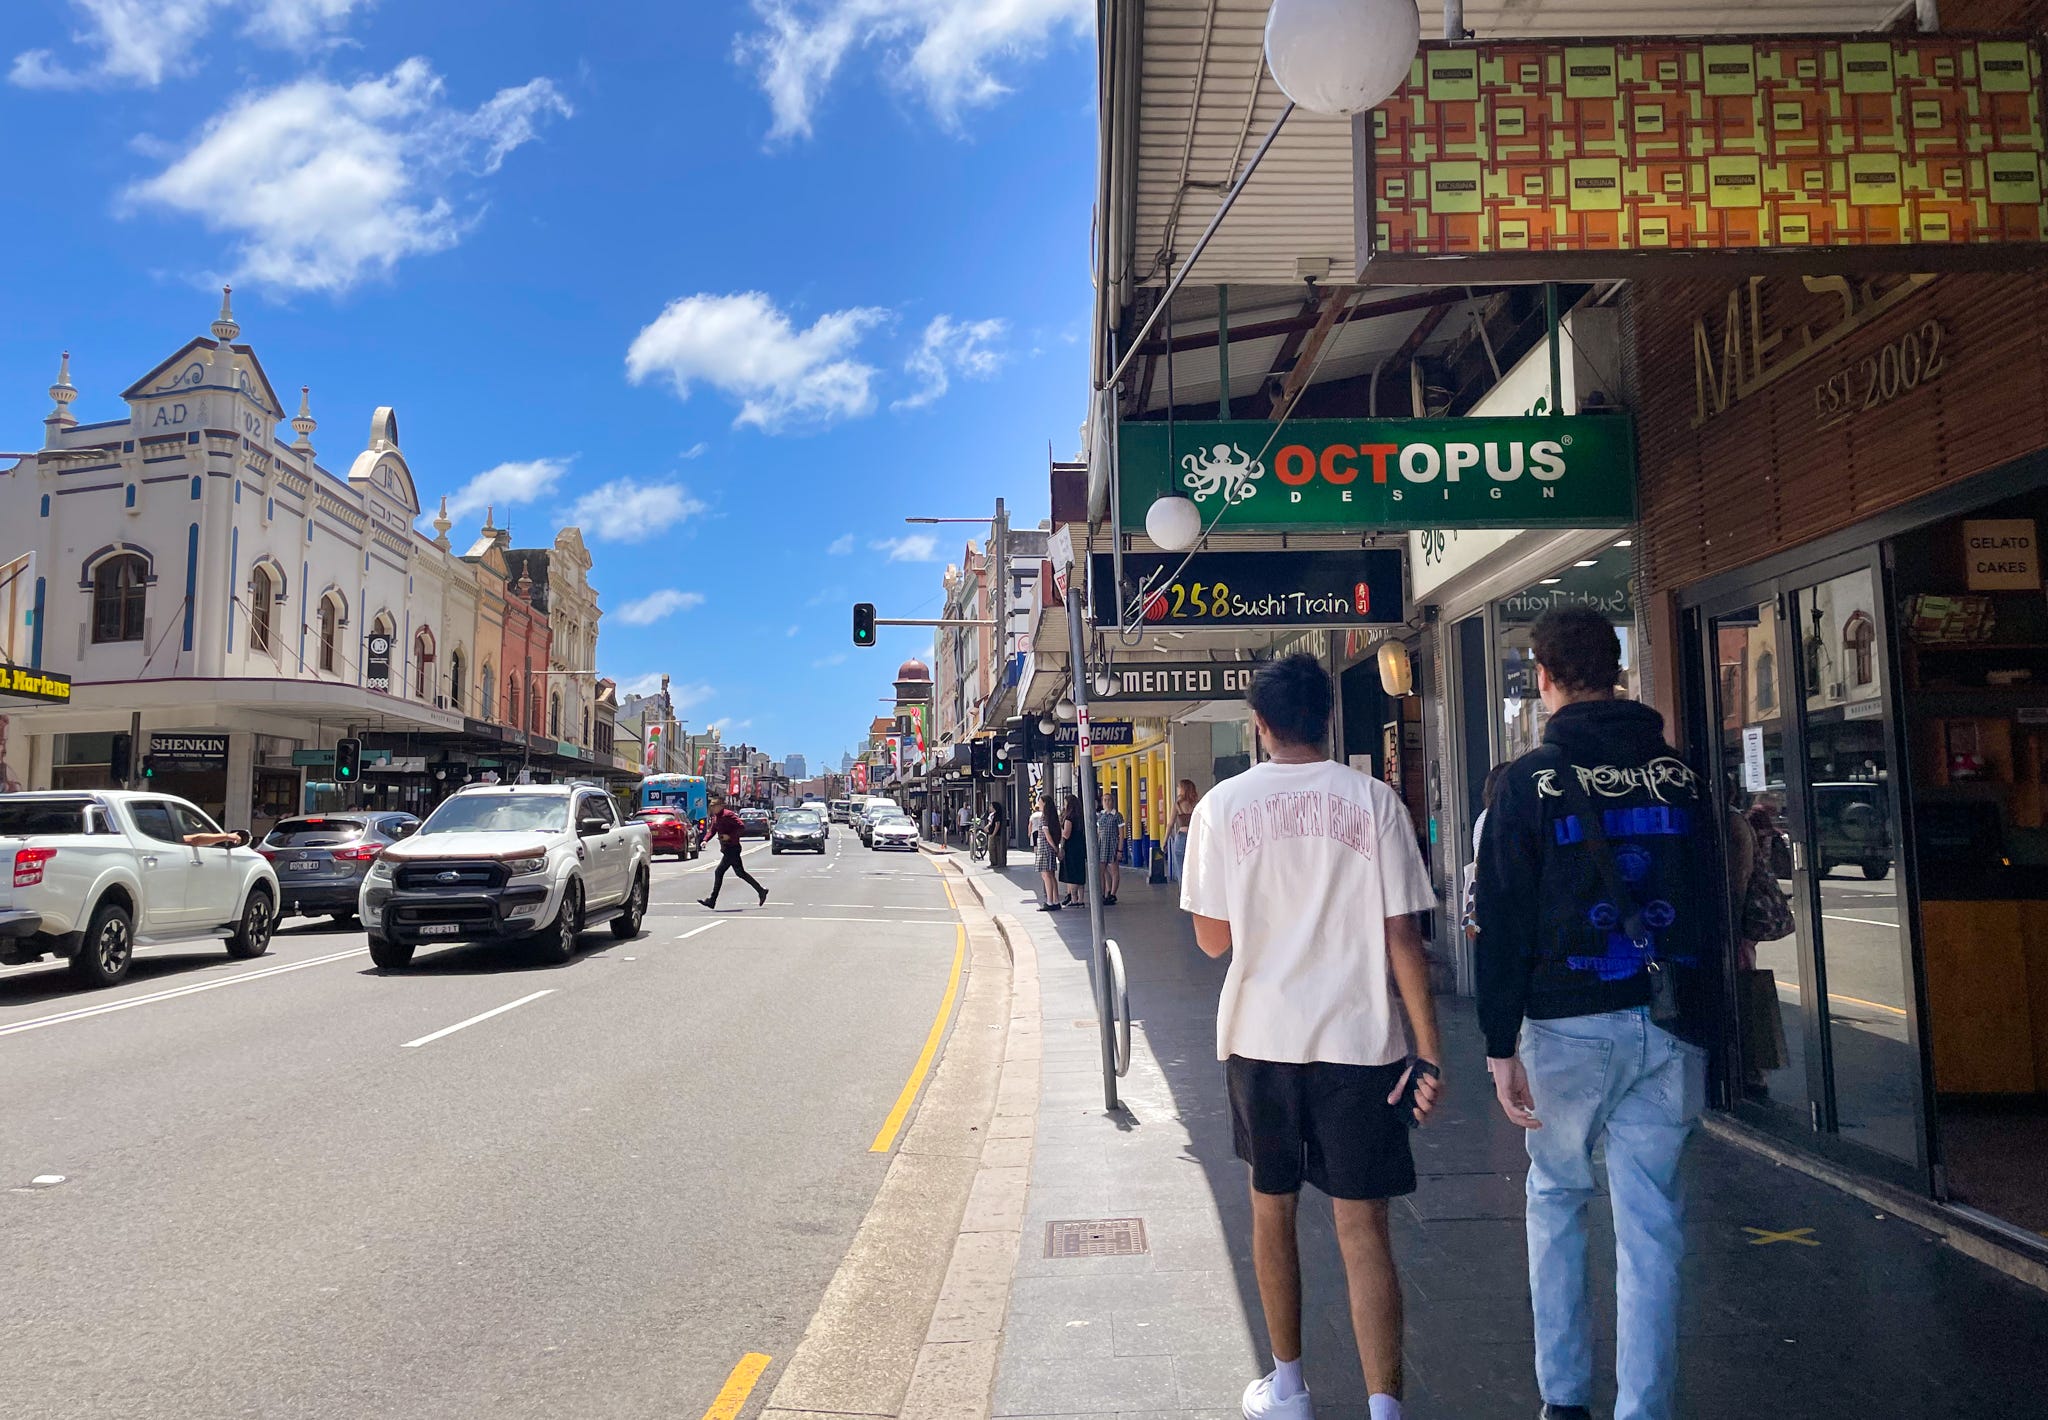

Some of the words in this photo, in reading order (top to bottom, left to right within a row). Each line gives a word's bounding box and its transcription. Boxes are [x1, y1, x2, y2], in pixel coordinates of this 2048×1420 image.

[1815, 364, 1853, 420] EST
[1860, 319, 1944, 411] 2002
[1290, 487, 1555, 504] DESIGN
[1970, 537, 2029, 549] GELATO
[1976, 562, 2027, 573] CAKES
[1171, 582, 1230, 618] 258
[1231, 593, 1286, 617] Sushi
[1288, 592, 1349, 616] Train
[12, 669, 70, 698] Martens
[1090, 727, 1127, 741] HEMIST
[151, 738, 225, 751] SHENKIN
